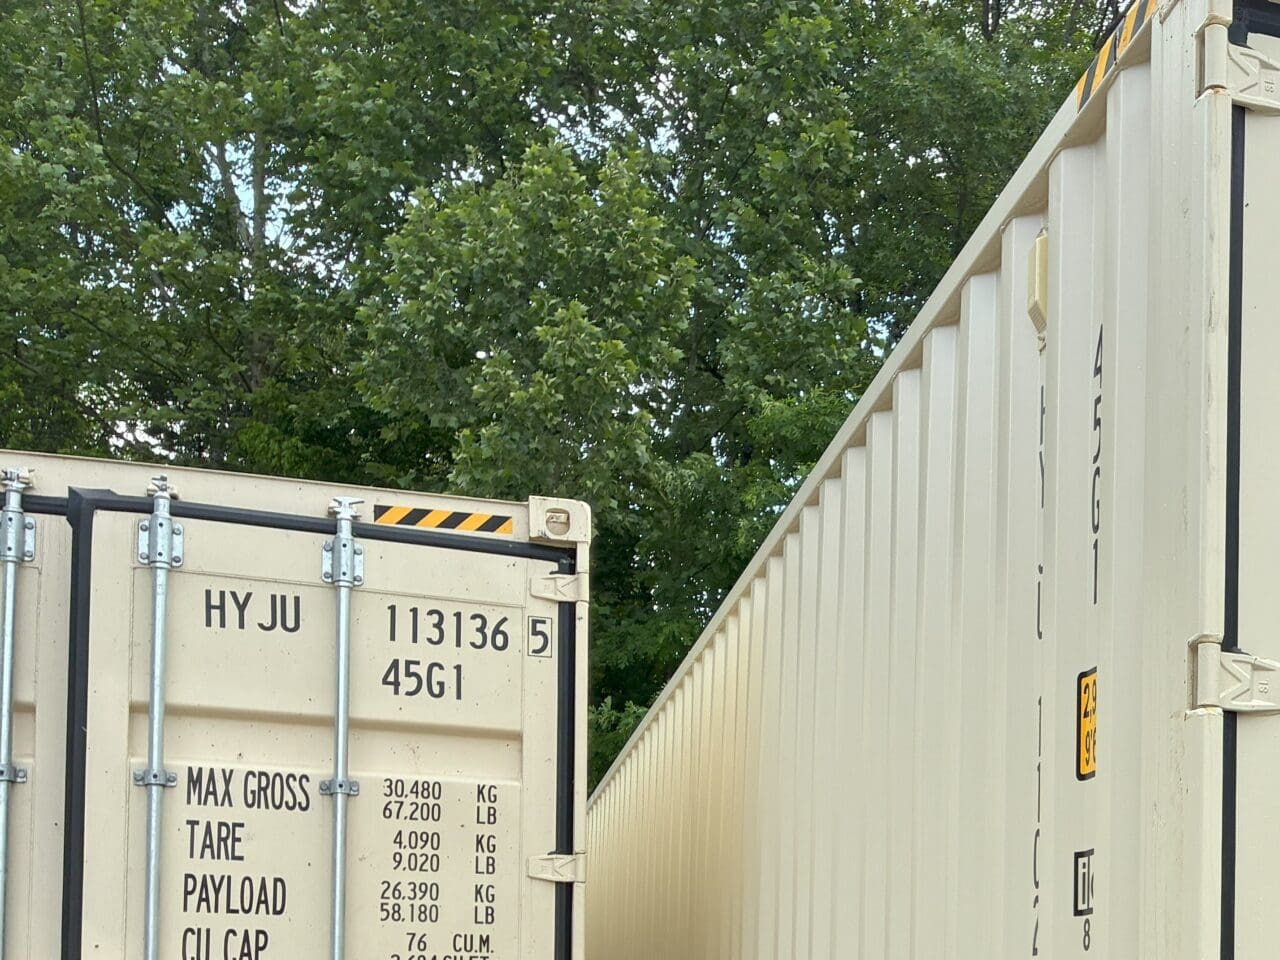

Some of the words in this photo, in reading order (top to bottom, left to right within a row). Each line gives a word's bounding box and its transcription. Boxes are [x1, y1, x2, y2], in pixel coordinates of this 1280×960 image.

[204, 588, 301, 634] HYJU
[386, 604, 510, 652] 113136
[530, 618, 550, 655] 5
[381, 658, 463, 700] 45G1
[186, 766, 234, 808] MAX
[243, 770, 311, 812] GROSS
[476, 783, 499, 805] KG
[476, 805, 498, 826] LB
[186, 819, 246, 862] TARE
[475, 834, 498, 854] KG
[474, 856, 497, 876] LB
[182, 873, 288, 917] PAYLOAD
[474, 884, 496, 905] KG
[473, 905, 496, 926] LB
[405, 931, 428, 953] 76
